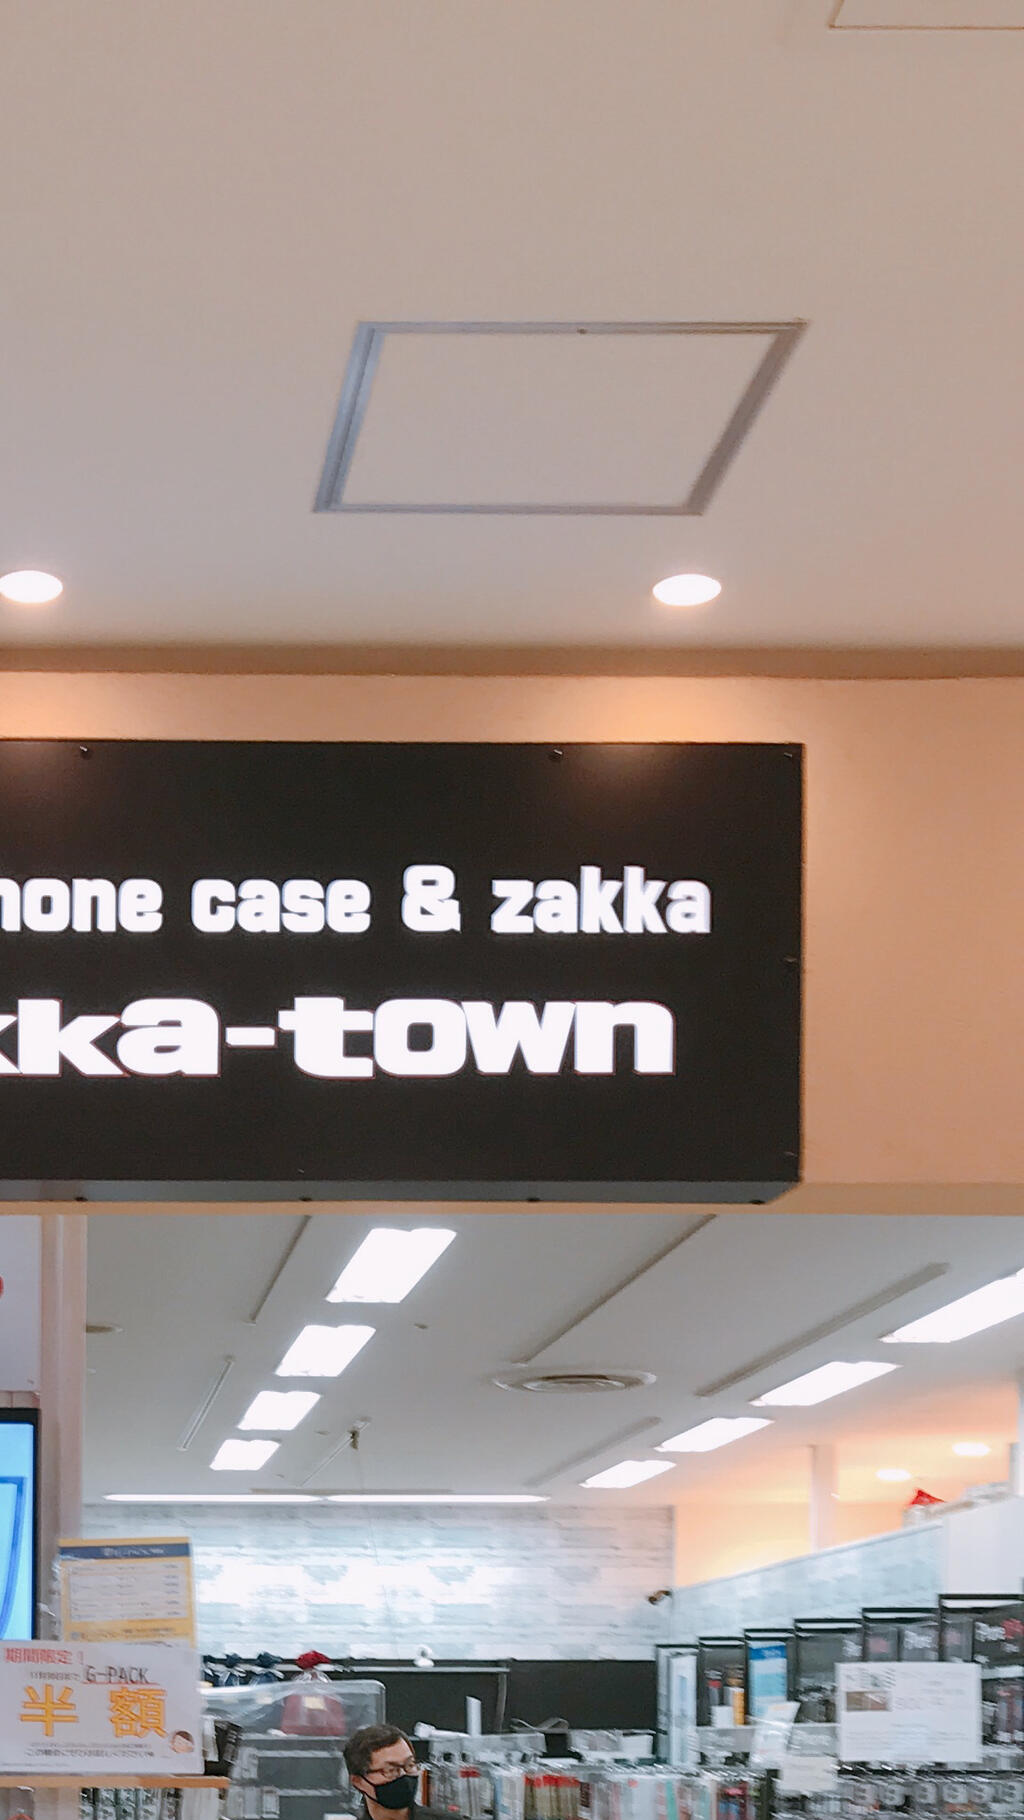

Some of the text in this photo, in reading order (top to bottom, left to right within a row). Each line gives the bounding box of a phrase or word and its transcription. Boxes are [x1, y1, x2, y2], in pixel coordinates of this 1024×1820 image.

[191, 872, 371, 934] case
[401, 865, 462, 934] &
[490, 865, 712, 935] zakka
[85, 1664, 150, 1684] G-PACK
